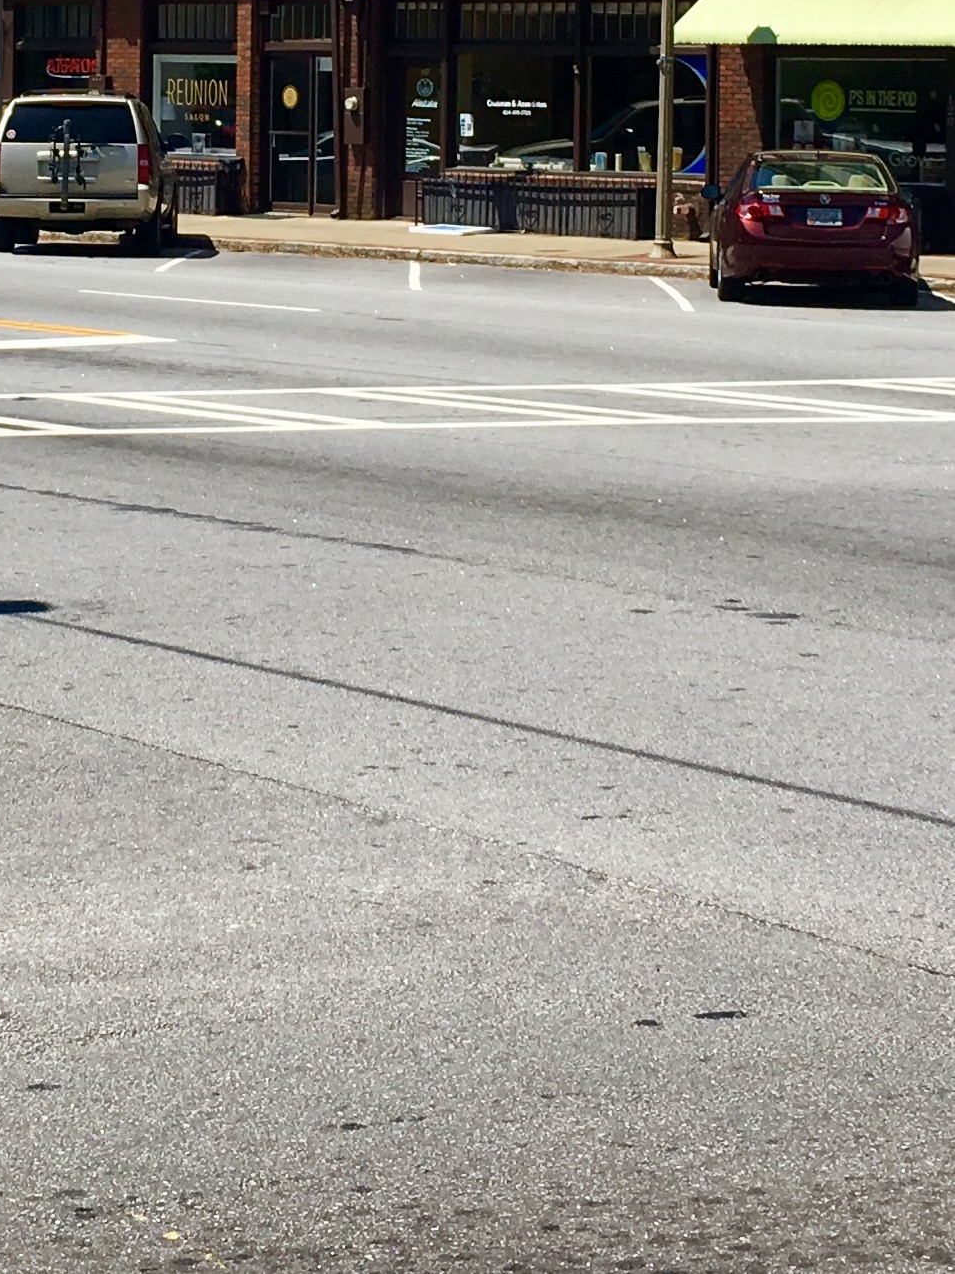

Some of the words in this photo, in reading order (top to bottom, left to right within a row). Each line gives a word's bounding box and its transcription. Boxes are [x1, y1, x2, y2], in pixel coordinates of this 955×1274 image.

[165, 78, 228, 107] REUNION
[876, 90, 897, 107] THE
[897, 90, 917, 107] POD
[184, 112, 210, 122] SALON
